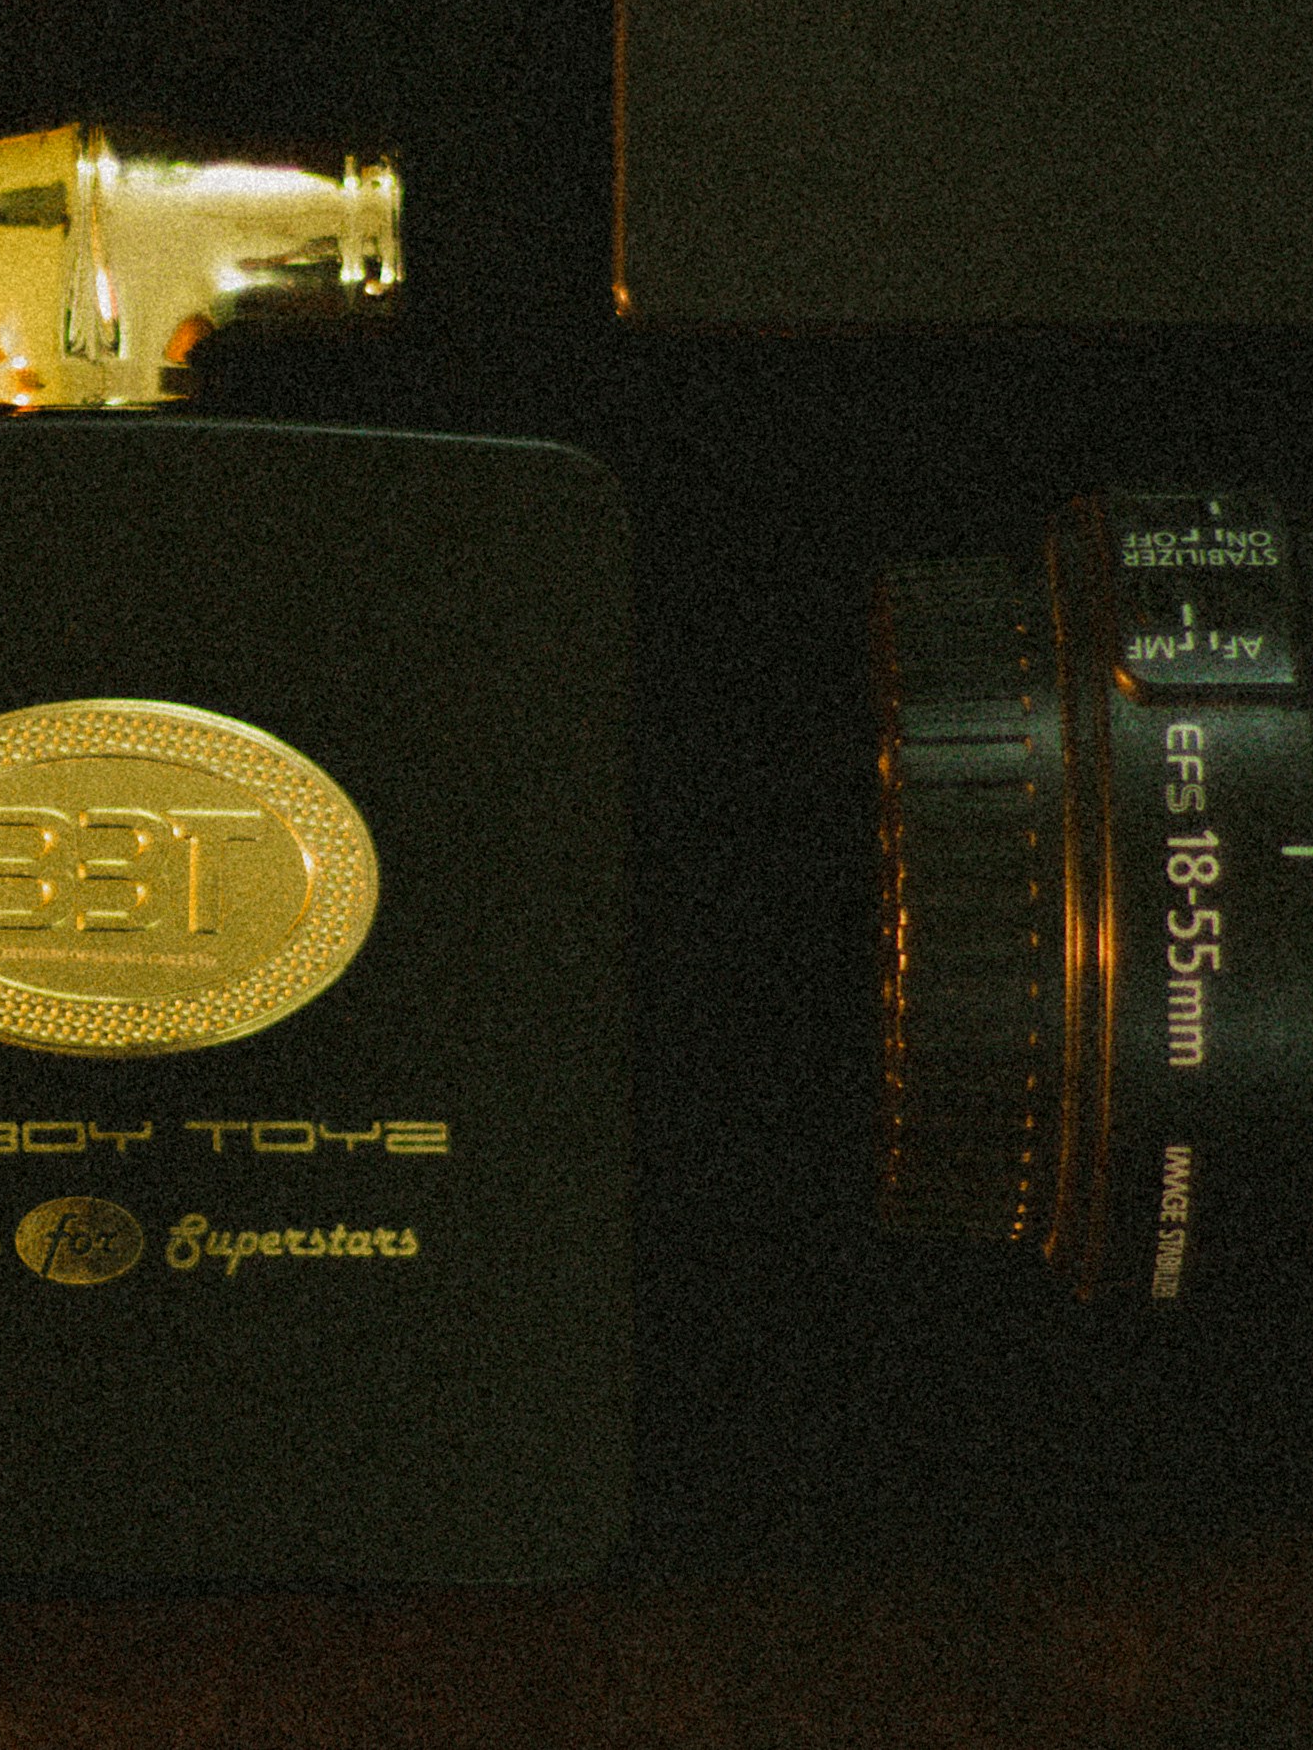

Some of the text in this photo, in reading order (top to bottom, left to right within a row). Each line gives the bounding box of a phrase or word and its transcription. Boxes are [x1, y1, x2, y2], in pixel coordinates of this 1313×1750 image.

[1121, 530, 1273, 549] ON OFF
[1121, 548, 1280, 567] STABILIZER
[1126, 635, 1264, 660] AF MF
[1166, 829, 1222, 1068] 18-55mm
[1159, 1144, 1194, 1223] IMAGE
[166, 1213, 418, 1275] Superstars
